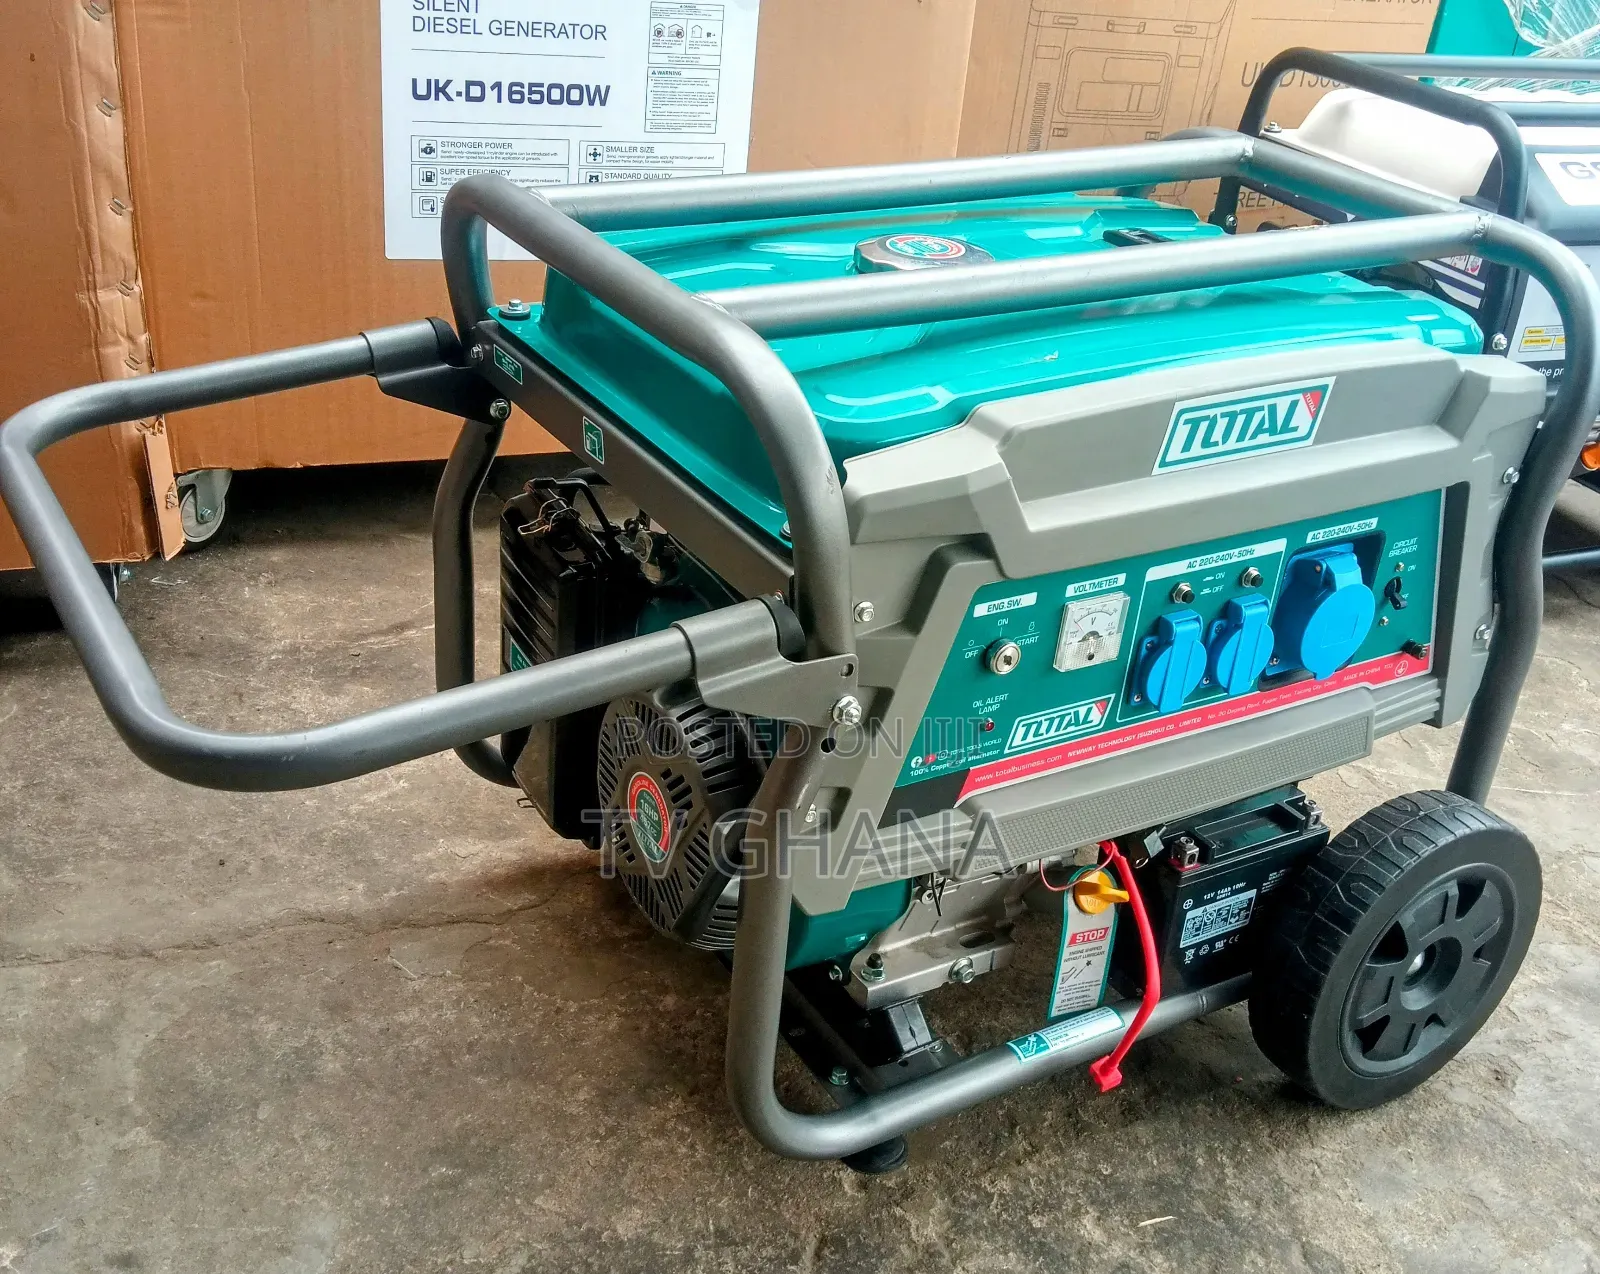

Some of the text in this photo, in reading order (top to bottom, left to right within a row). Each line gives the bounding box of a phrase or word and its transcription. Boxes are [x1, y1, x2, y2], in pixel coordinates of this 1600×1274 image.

[412, 0, 479, 13] SILENT
[412, 15, 607, 41] DIESEL GENERATOR
[411, 77, 611, 107] UK-D16500W
[440, 140, 513, 150] STRONGER POWER
[605, 145, 655, 154] SMALLER SIZE
[439, 168, 511, 177] SUPER EFFICIENCY
[604, 172, 642, 180] STANDARD
[1305, 392, 1316, 414] TOTAL
[1181, 398, 1301, 454] TOTAL
[1311, 533, 1321, 541] AC
[1393, 538, 1418, 549] CIRCUIT
[1388, 545, 1418, 557] BREAKER
[1186, 561, 1197, 570] AC
[1215, 572, 1225, 580] ON
[1073, 577, 1119, 593] VOLTMETER
[1212, 585, 1224, 593] OFF
[987, 598, 1023, 613] ENG.SW.
[997, 618, 1009, 626] ON
[1016, 635, 1039, 647] START
[965, 650, 979, 659] OFF
[972, 693, 1009, 708] OIL ALERT
[978, 703, 1000, 715] LAMP
[974, 754, 1062, 783] www.totalbusiness.com
[1067, 746, 1096, 758] NEWWAY
[1098, 735, 1136, 750] TECHNOLOGY
[1178, 717, 1202, 728] LIMITED
[1343, 672, 1358, 681] MADE
[1365, 666, 1380, 676] CHINA
[1019, 705, 1095, 742] TOTAL
[909, 766, 929, 777] 100%
[967, 749, 1000, 762] alternator
[640, 799, 659, 821] 16HP
[1203, 891, 1215, 900] 12V
[1075, 929, 1105, 943] STOP
[1063, 954, 1082, 963] WITHOUT
